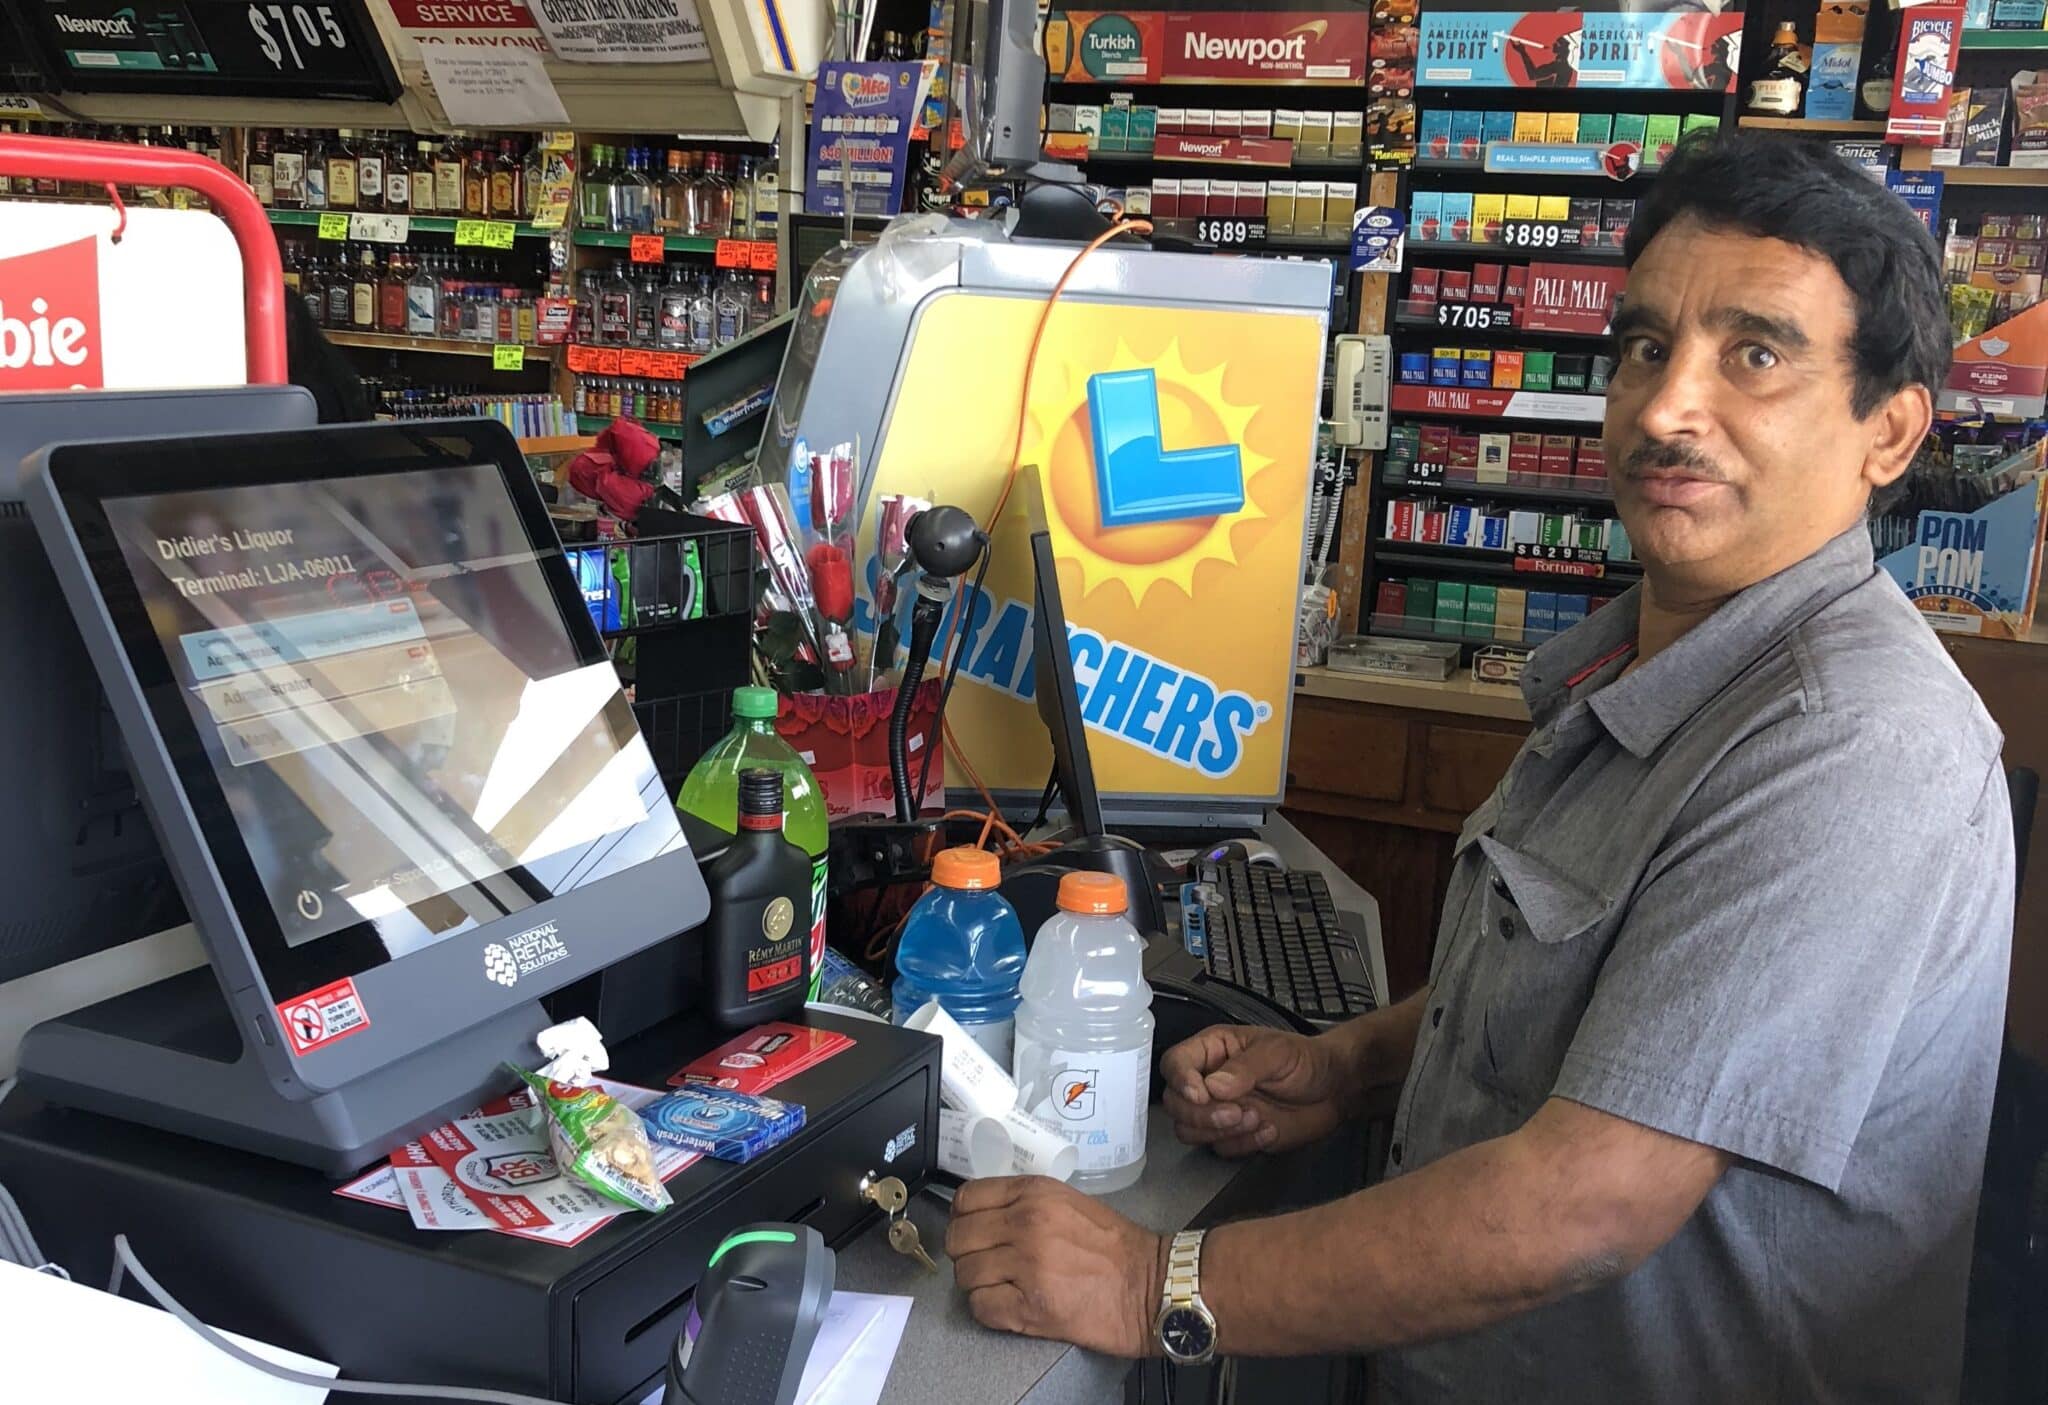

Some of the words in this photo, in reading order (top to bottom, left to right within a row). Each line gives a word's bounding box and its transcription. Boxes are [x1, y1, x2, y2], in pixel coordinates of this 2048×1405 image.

[416, 5, 517, 22] SERVICE
[54, 14, 134, 37] Newport
[1428, 30, 1488, 40] AMERICAN
[1581, 30, 1644, 40] AMERICAN
[1912, 20, 1952, 38] BICYCLE
[1088, 32, 1135, 50] Turkish
[1184, 31, 1306, 65] Newport
[1427, 42, 1486, 60] SPIRIT
[1580, 42, 1642, 60] SPIRIT
[1823, 57, 1851, 68] Midol
[1924, 61, 1952, 85] JUMBO
[860, 76, 889, 95] MEGA
[1967, 118, 2000, 136] Black
[1975, 129, 2000, 143] Mild
[1179, 141, 1223, 156] Newport
[1835, 145, 1880, 158] Zantac
[276, 171, 290, 181] 101
[1916, 185, 1936, 194] CARDS
[1533, 277, 1565, 307] PALL
[1570, 279, 1608, 310] MALL
[1969, 371, 2008, 381] BLAZING
[1427, 390, 1446, 408] PALL
[1449, 391, 1470, 410] MALL
[722, 398, 762, 426] Winterfresh
[1400, 505, 1410, 537] Fortuna
[1920, 515, 1988, 552] POM
[157, 534, 233, 560] Didier's
[233, 529, 295, 552] Liquor
[171, 567, 264, 598] Terminal:
[265, 554, 356, 585] LJA-06011
[1534, 560, 1585, 576] Fortuna
[1916, 545, 1986, 594] POM
[508, 923, 558, 950] NATIONAL
[512, 934, 564, 964] RETAIL
[520, 946, 568, 974] SOLUTIONS
[656, 1128, 716, 1153] Winterfresh
[499, 1158, 541, 1179] BR
